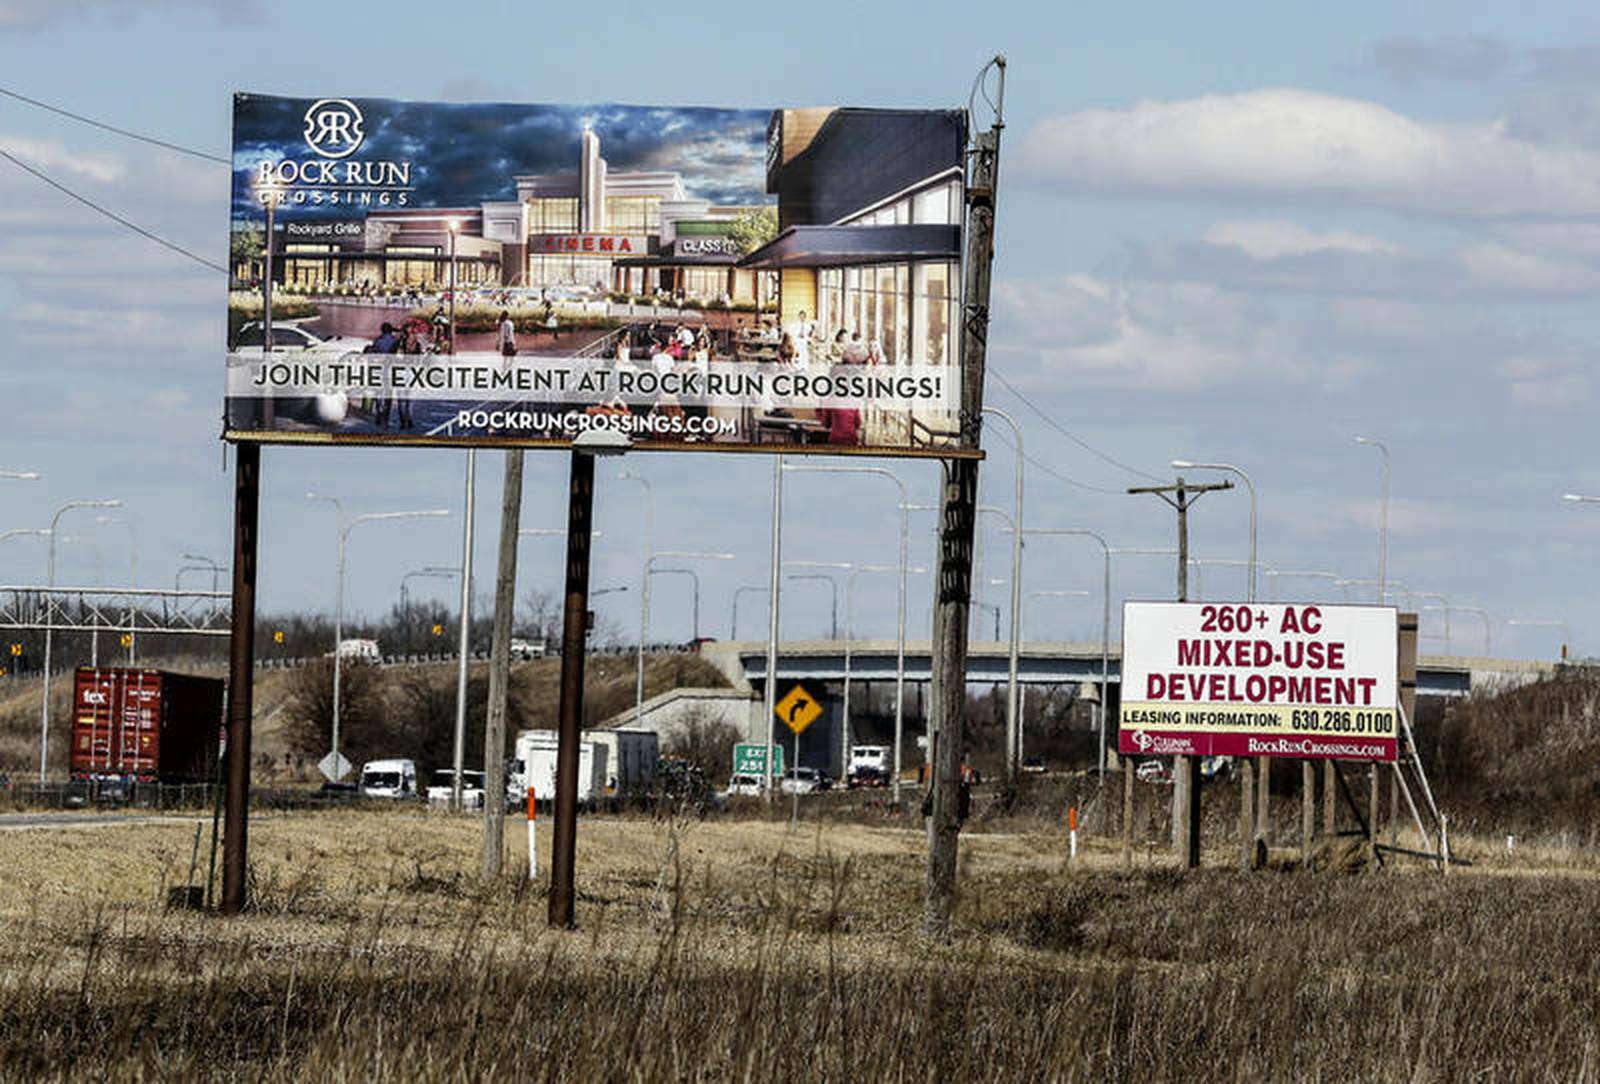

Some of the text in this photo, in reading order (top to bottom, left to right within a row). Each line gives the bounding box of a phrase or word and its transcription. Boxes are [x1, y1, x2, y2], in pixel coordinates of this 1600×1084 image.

[259, 160, 411, 185] ROCK RUN
[257, 191, 408, 206] CROSSINGS
[287, 223, 332, 236] Rockyard
[544, 236, 633, 252] CINEMA
[254, 363, 942, 399] JOIN THE EXCITEMENT AT ROCK RUN CROSSINGS!
[458, 410, 737, 435] ROCKRUNCROSSINGS.COM
[1200, 605, 1322, 635] 260+ AC
[1177, 638, 1345, 670] MIXED-USE
[1146, 673, 1377, 706] DEVELOPMENT
[1123, 709, 1393, 733] LEASING INFORMATION: 630.286.0100
